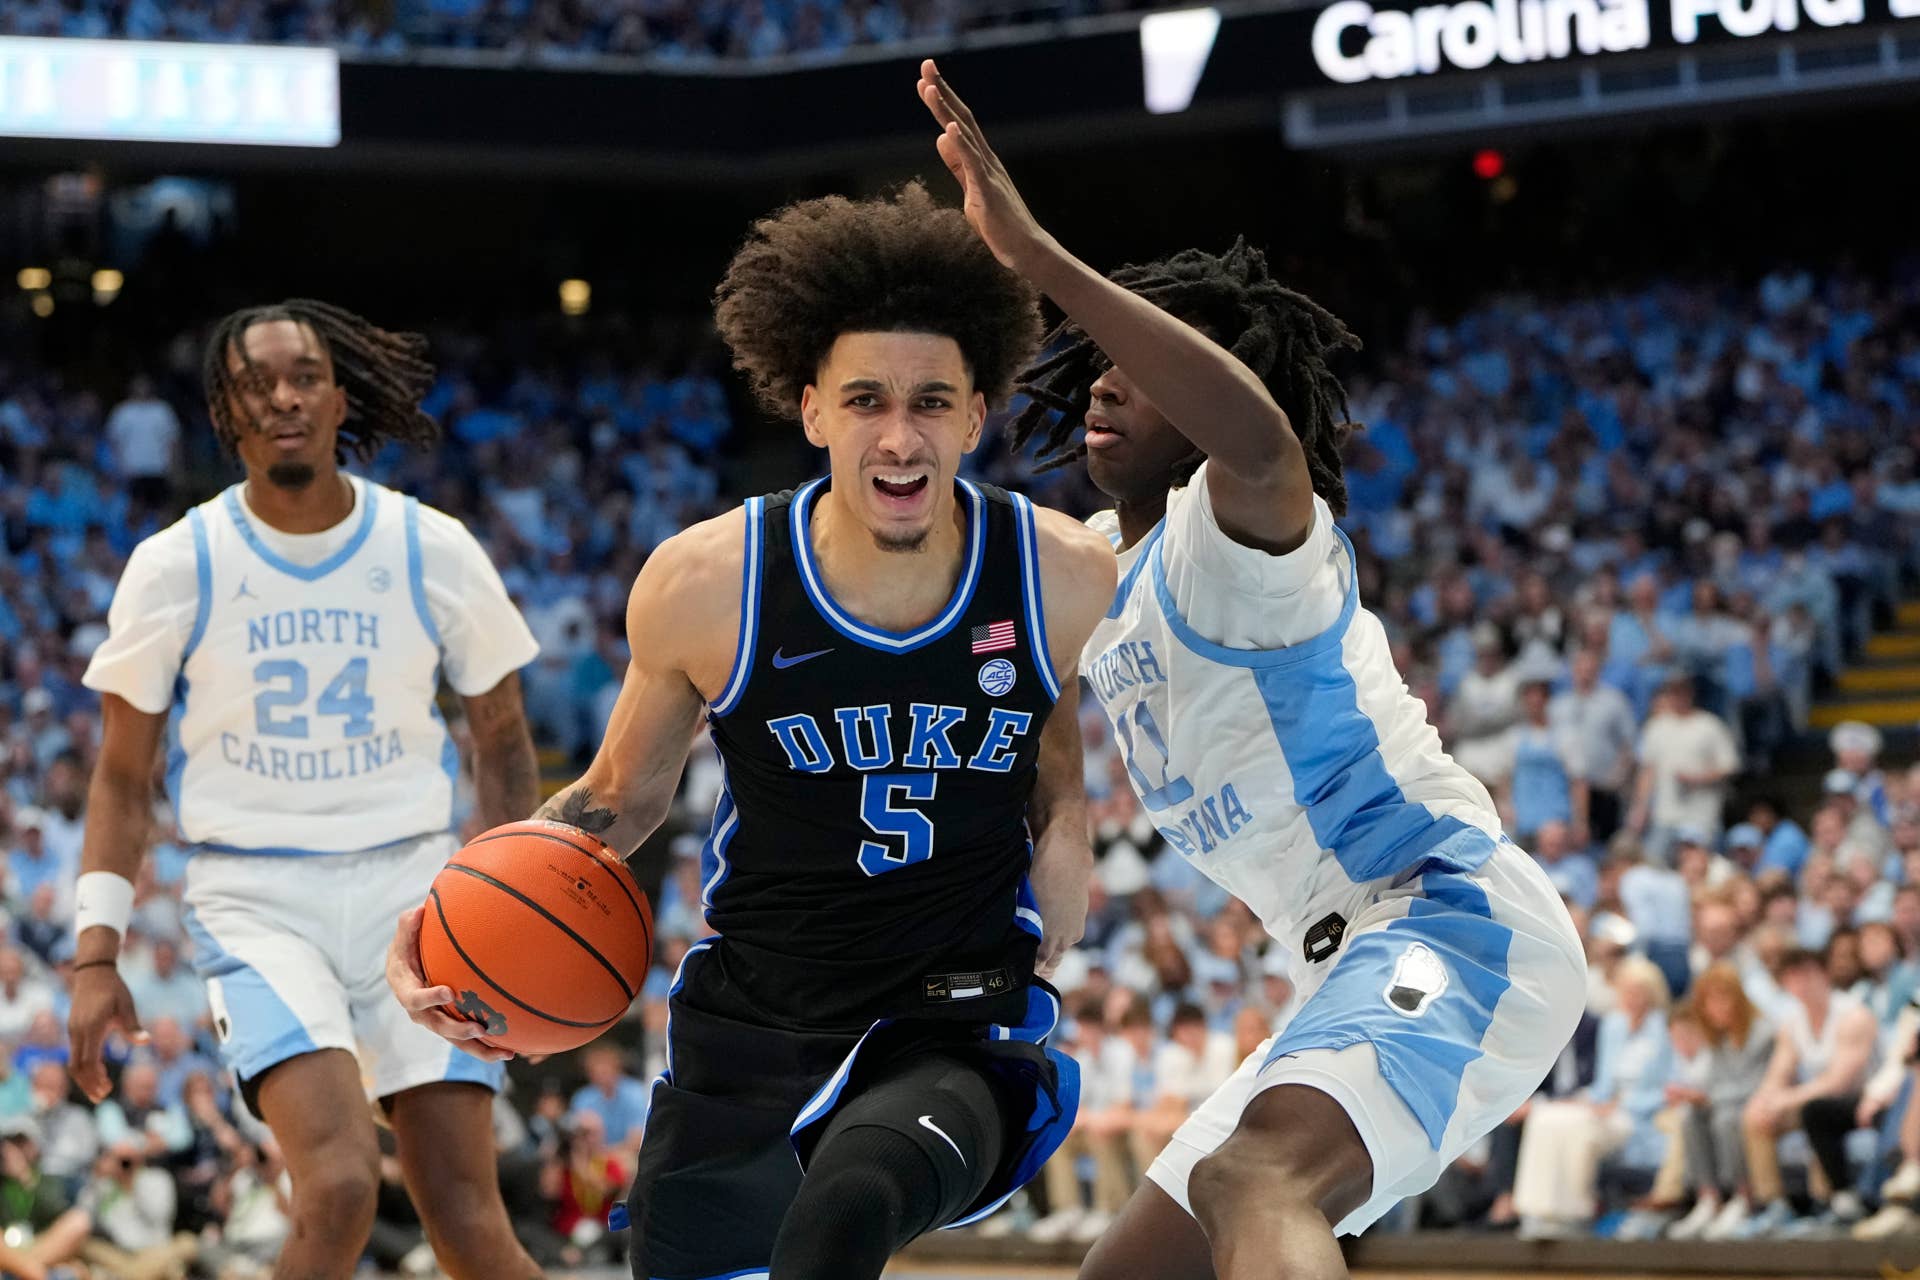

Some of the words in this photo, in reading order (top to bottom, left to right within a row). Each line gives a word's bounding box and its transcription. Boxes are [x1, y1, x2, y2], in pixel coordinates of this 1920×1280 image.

[1311, 0, 1649, 83] Carolina
[247, 608, 380, 653] NORTH
[253, 656, 375, 739] 24
[985, 669, 1012, 680] ACC
[220, 728, 404, 783] CAROLINA
[766, 702, 1034, 774] DUKE
[1117, 700, 1194, 813] 11
[856, 772, 938, 877] 5
[988, 976, 1004, 989] 46
